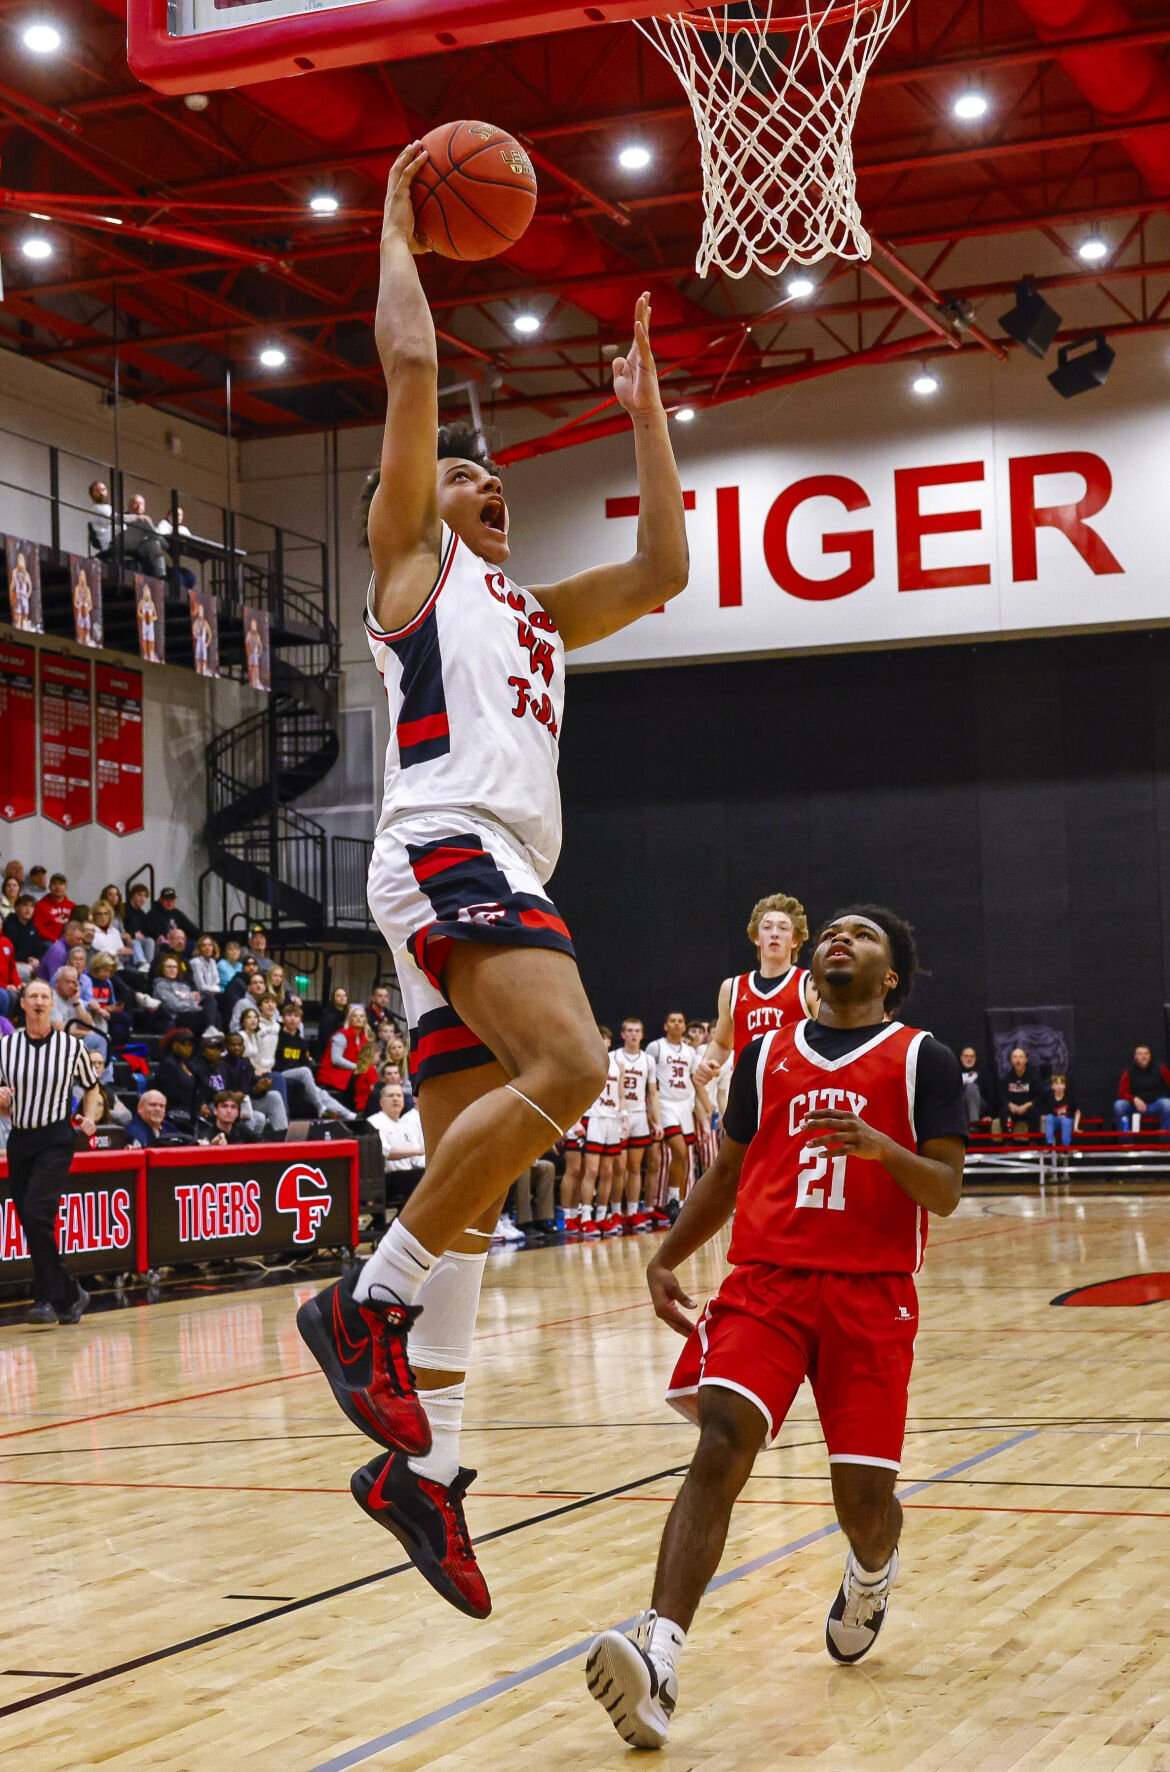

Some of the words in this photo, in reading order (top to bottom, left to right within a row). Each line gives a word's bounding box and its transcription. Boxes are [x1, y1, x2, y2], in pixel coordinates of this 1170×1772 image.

[747, 1006, 784, 1030] CITY
[624, 1076, 637, 1089] 23
[794, 1146, 847, 1211] 21
[54, 1188, 132, 1255] FALLS
[174, 1179, 262, 1242] TIGERS
